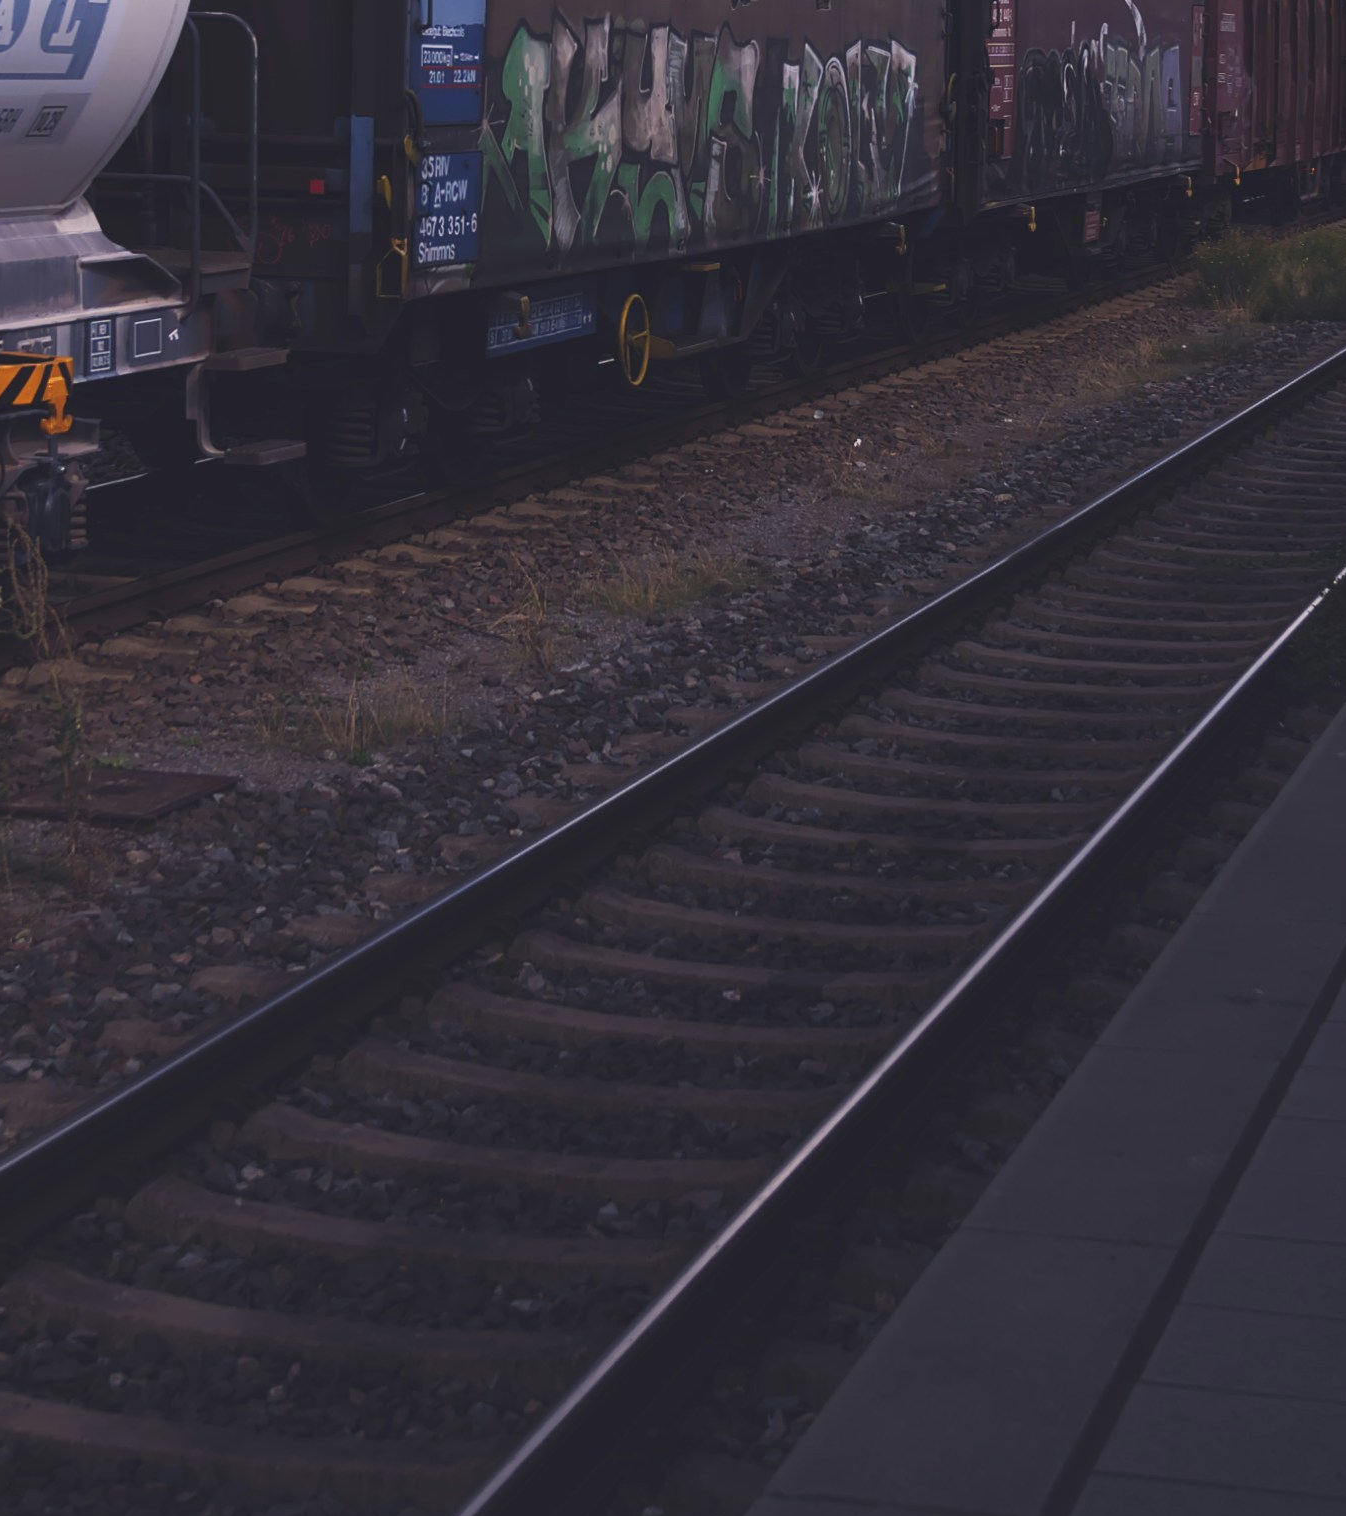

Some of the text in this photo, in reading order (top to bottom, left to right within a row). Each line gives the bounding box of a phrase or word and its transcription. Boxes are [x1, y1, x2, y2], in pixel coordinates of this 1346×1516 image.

[421, 154, 451, 180] 35 RIV
[433, 179, 468, 207] A-RCW
[419, 212, 478, 238] 4673 351-6
[417, 240, 456, 264] Shimmns
